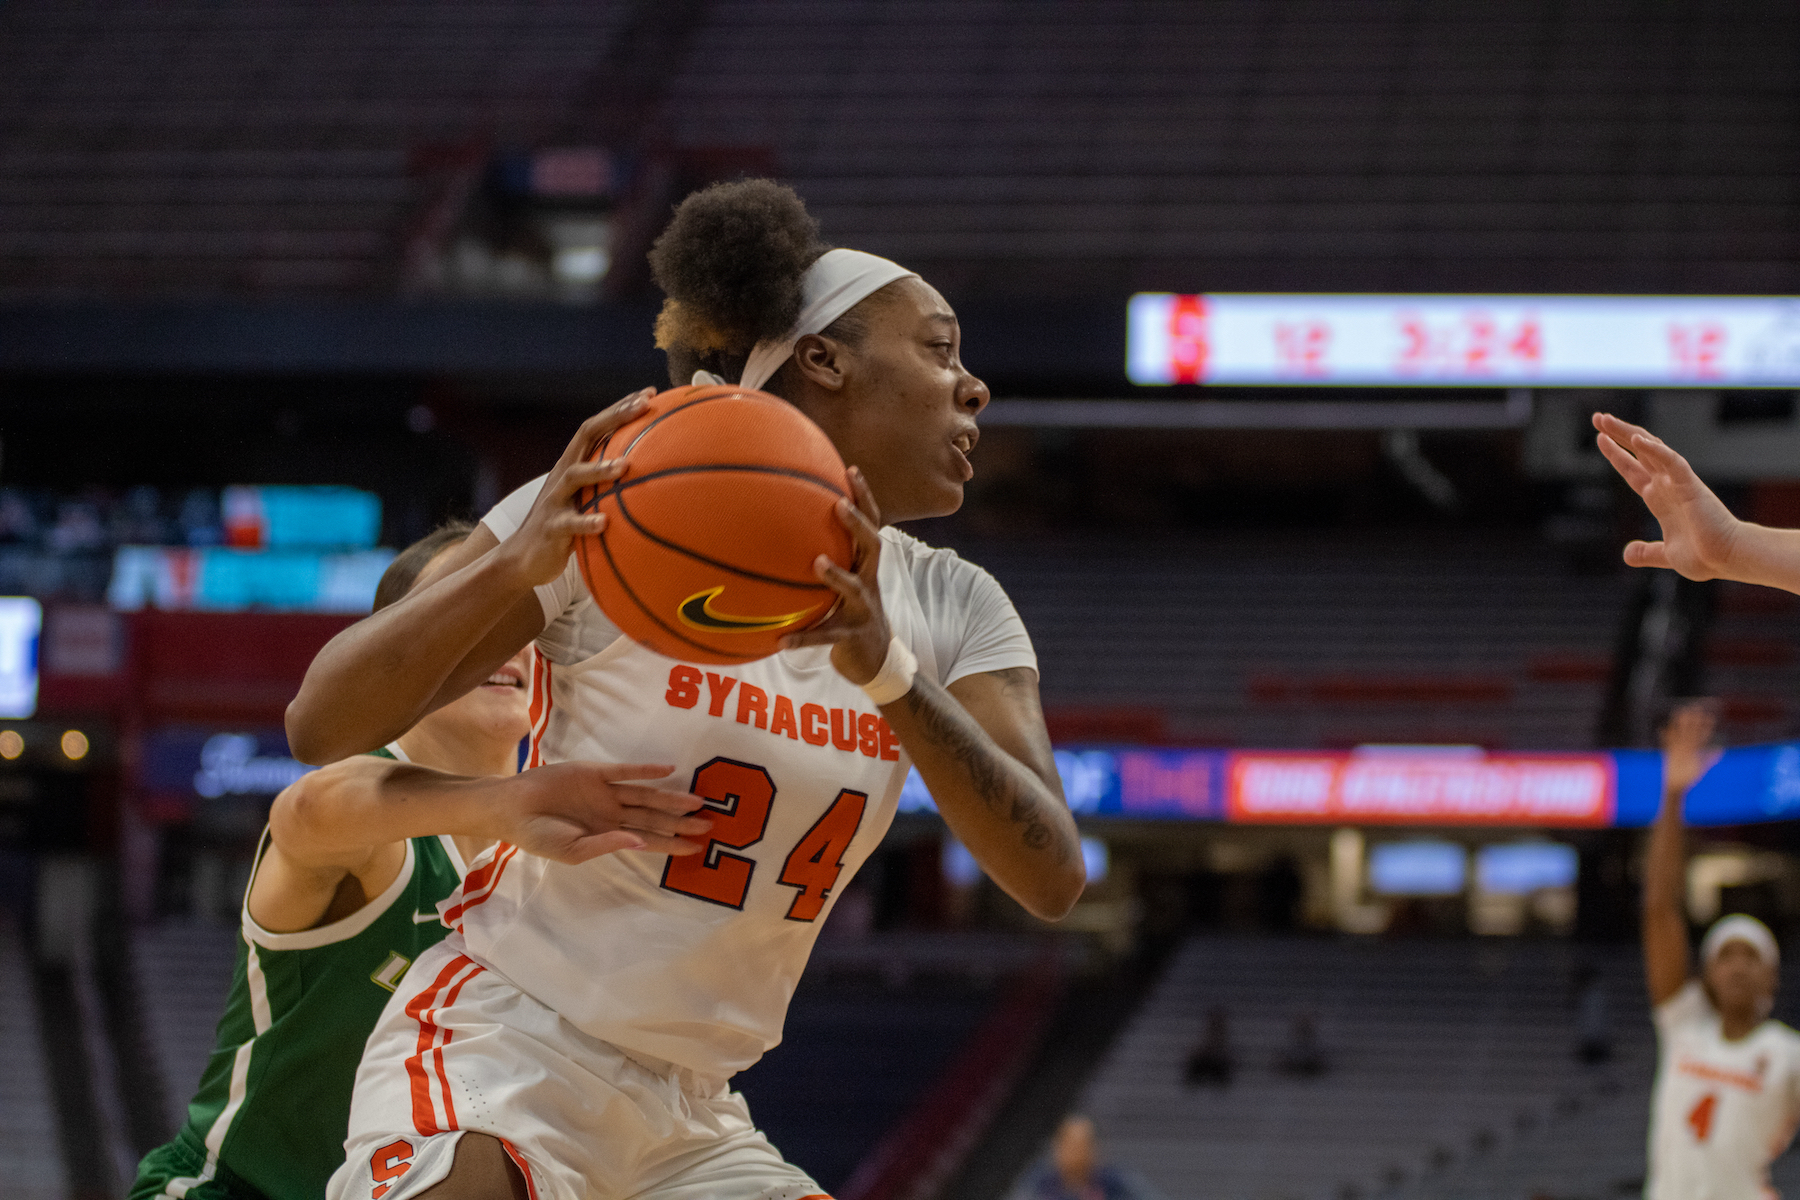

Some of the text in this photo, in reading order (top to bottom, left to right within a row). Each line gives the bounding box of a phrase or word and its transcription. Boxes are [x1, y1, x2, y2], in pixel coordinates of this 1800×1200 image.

[665, 664, 900, 761] SYRACUSE
[660, 756, 868, 923] 24
[1686, 1092, 1718, 1146] 4
